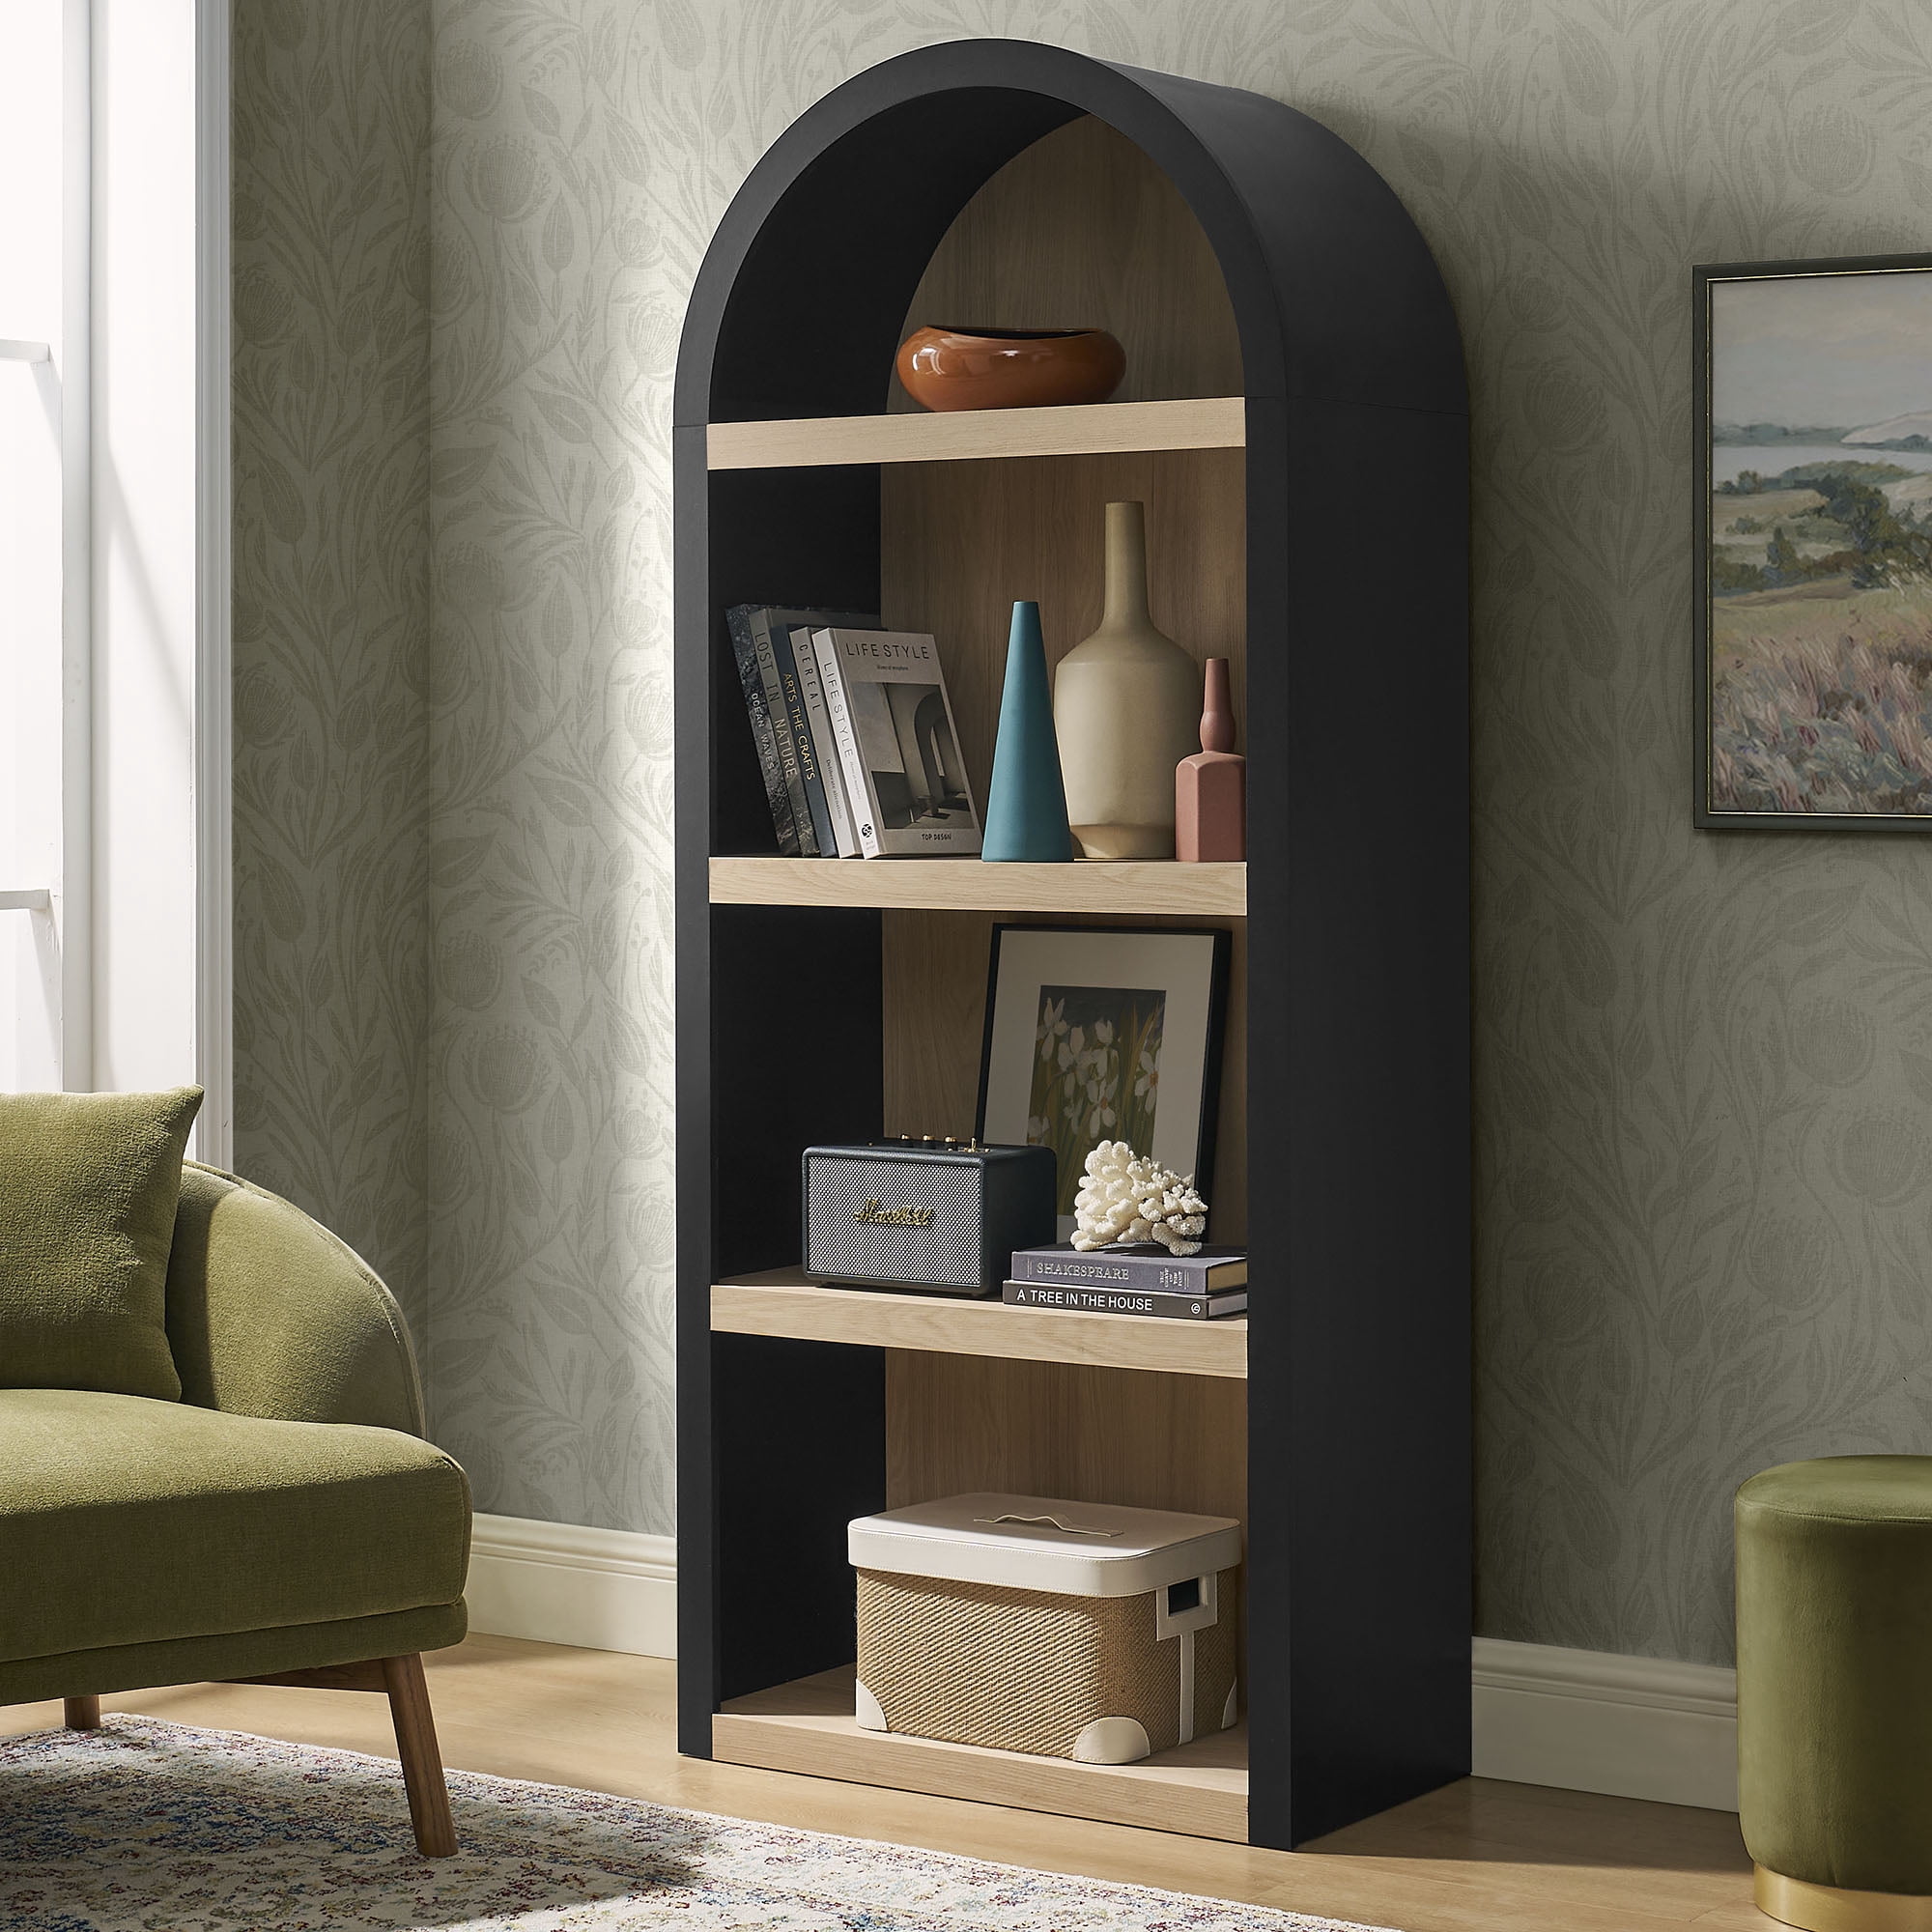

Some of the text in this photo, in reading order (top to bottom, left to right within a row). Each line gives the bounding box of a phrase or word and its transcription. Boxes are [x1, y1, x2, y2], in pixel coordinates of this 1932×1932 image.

[799, 643, 821, 711] CEREAL
[845, 642, 930, 660] LIFESTYLE
[751, 693, 775, 770] OCEAN WAVES
[754, 632, 797, 779] LOST IN NATURE
[783, 673, 816, 781] ARTS THE CRAFTS
[823, 662, 853, 758] LIFESTYLE
[1016, 1289, 1152, 1311] A TREE IN THE HOUSE
[1036, 1262, 1129, 1280] SHAKESPEARE
